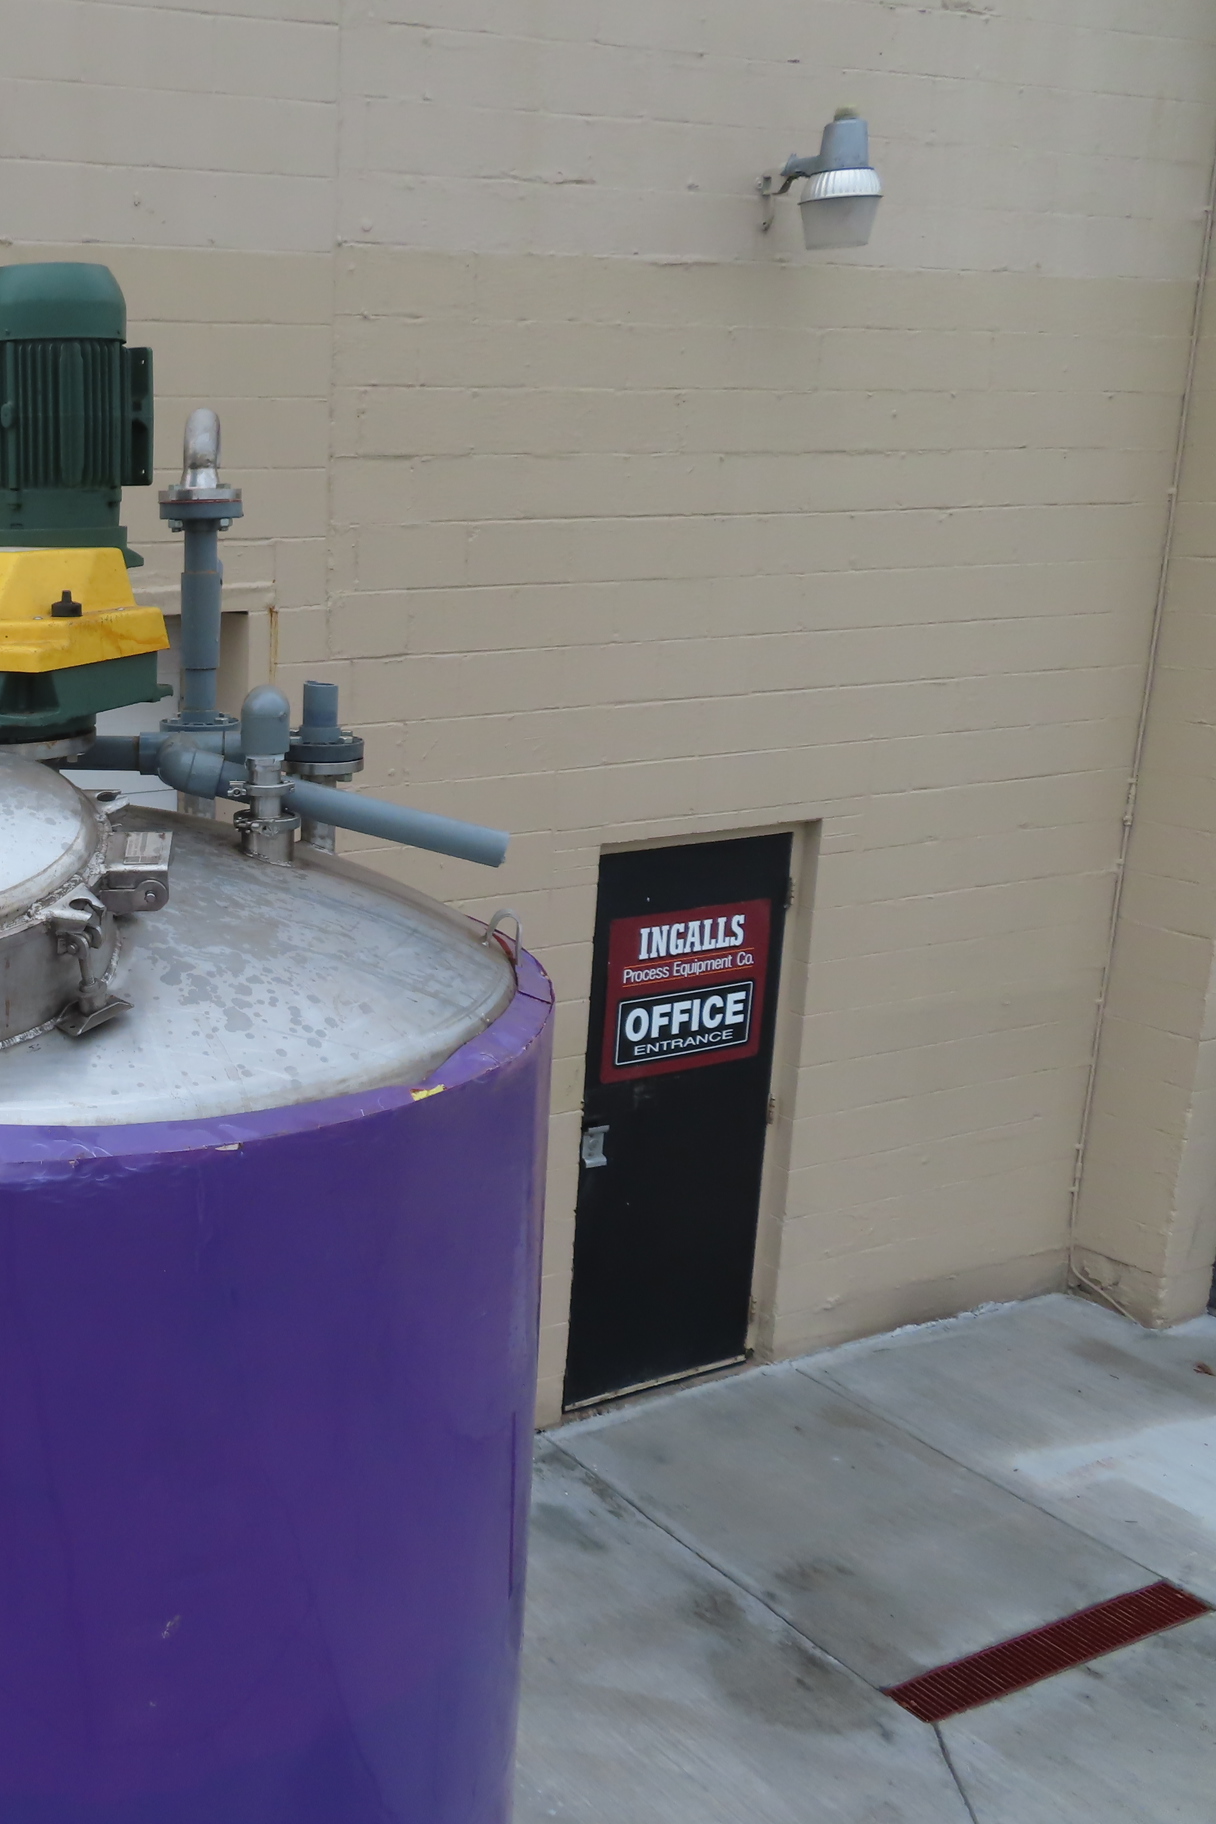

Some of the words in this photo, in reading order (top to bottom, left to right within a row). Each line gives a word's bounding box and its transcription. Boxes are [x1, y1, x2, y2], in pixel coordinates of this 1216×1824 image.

[639, 914, 745, 960] INGALLS
[623, 965, 670, 984] Process
[673, 955, 733, 978] Equipment
[736, 951, 755, 967] Co.
[625, 991, 746, 1042] OFFICE
[634, 1028, 734, 1056] ENTRANCE
